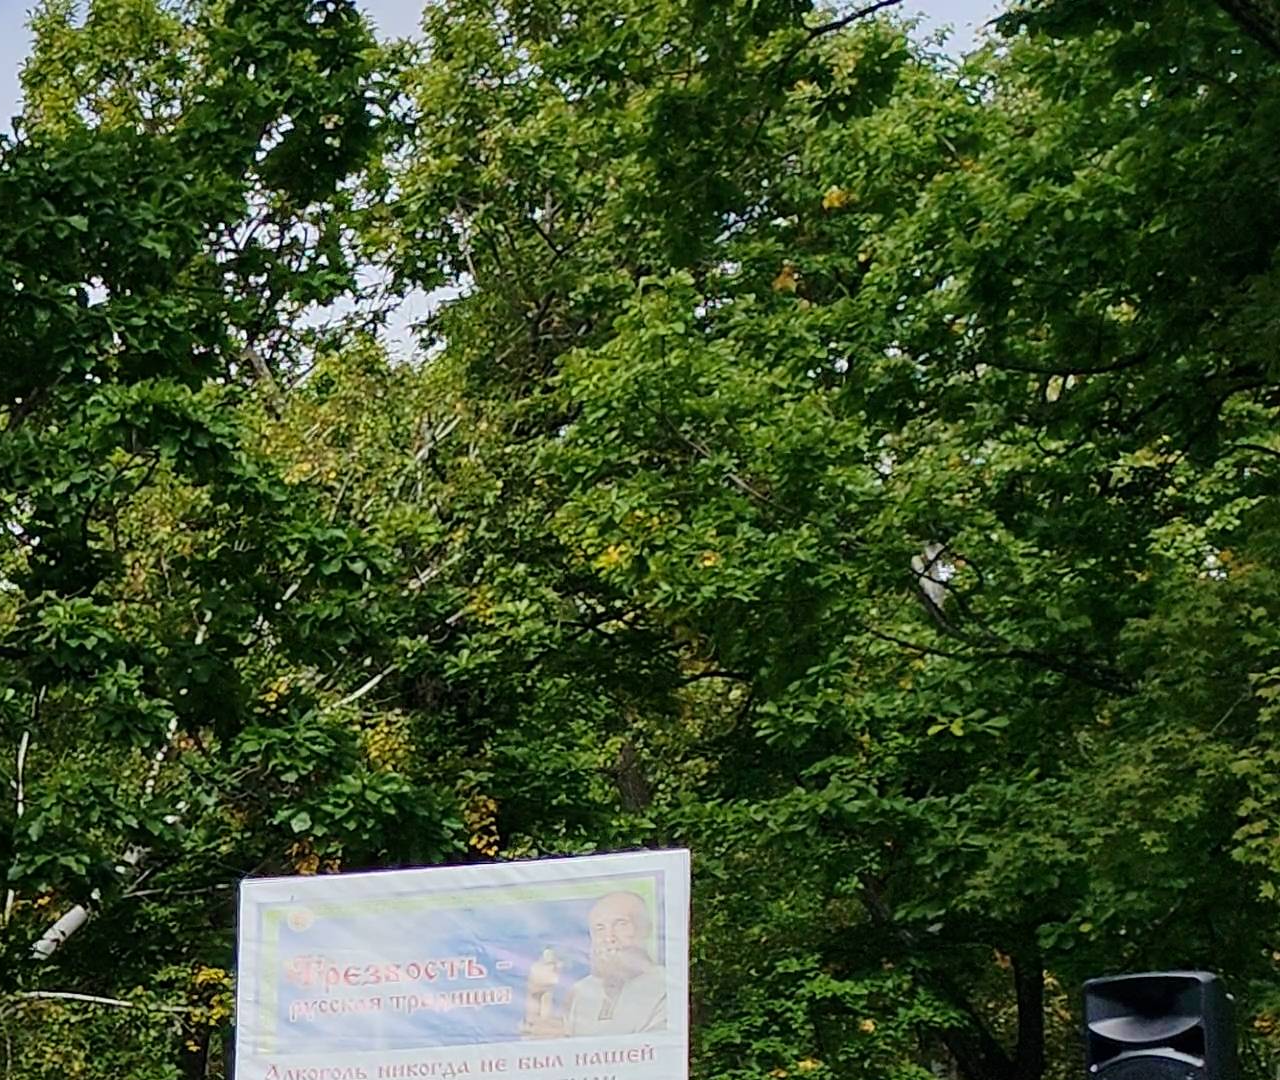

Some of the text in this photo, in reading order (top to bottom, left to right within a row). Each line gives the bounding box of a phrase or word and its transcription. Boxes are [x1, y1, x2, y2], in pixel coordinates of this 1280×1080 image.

[287, 955, 487, 992] Трезвость
[378, 1060, 470, 1079] никогда
[481, 1058, 507, 1073] не
[517, 1054, 564, 1070] был
[575, 1044, 655, 1065] нашей
